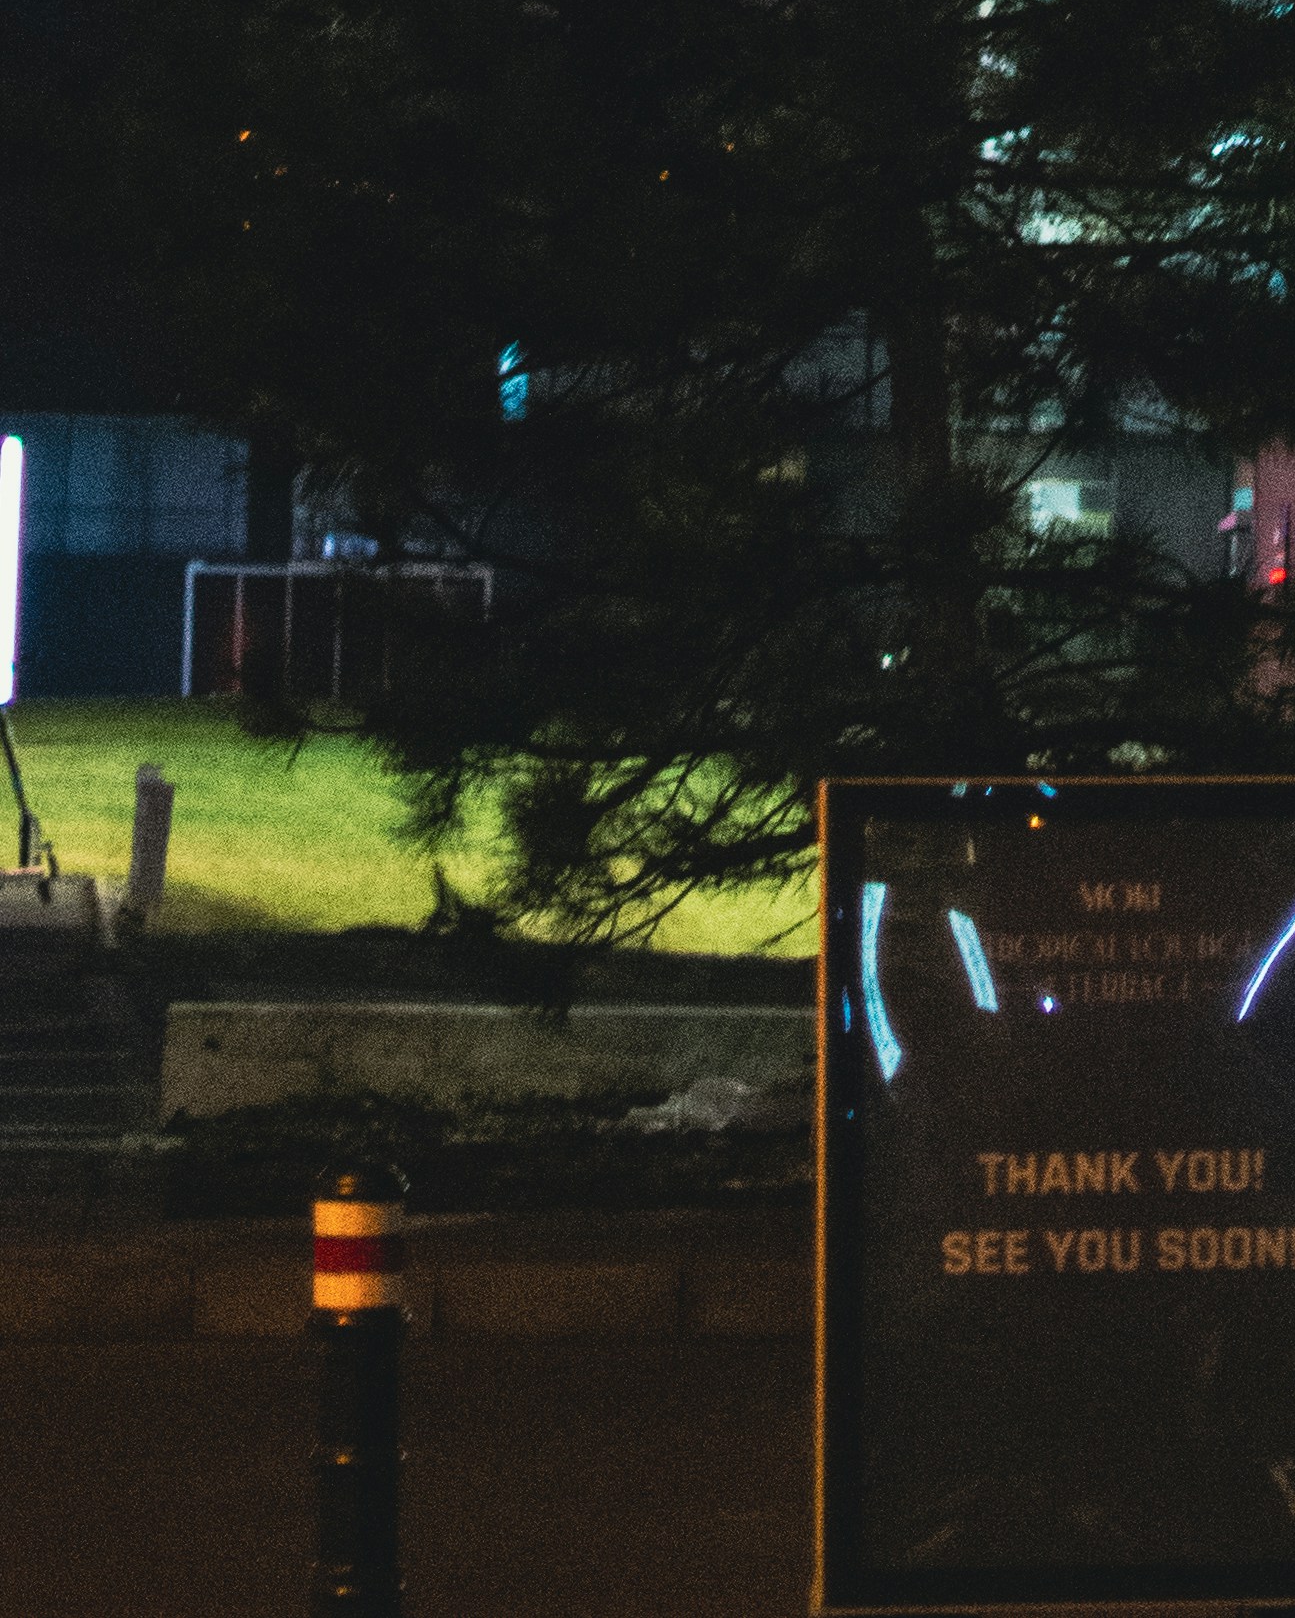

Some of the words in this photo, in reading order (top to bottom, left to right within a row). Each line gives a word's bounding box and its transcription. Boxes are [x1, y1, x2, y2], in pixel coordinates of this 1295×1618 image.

[976, 1150, 1142, 1197] THANK
[1153, 1148, 1267, 1194] YOU!
[940, 1230, 1031, 1277] SEE
[1043, 1228, 1143, 1274] YOU
